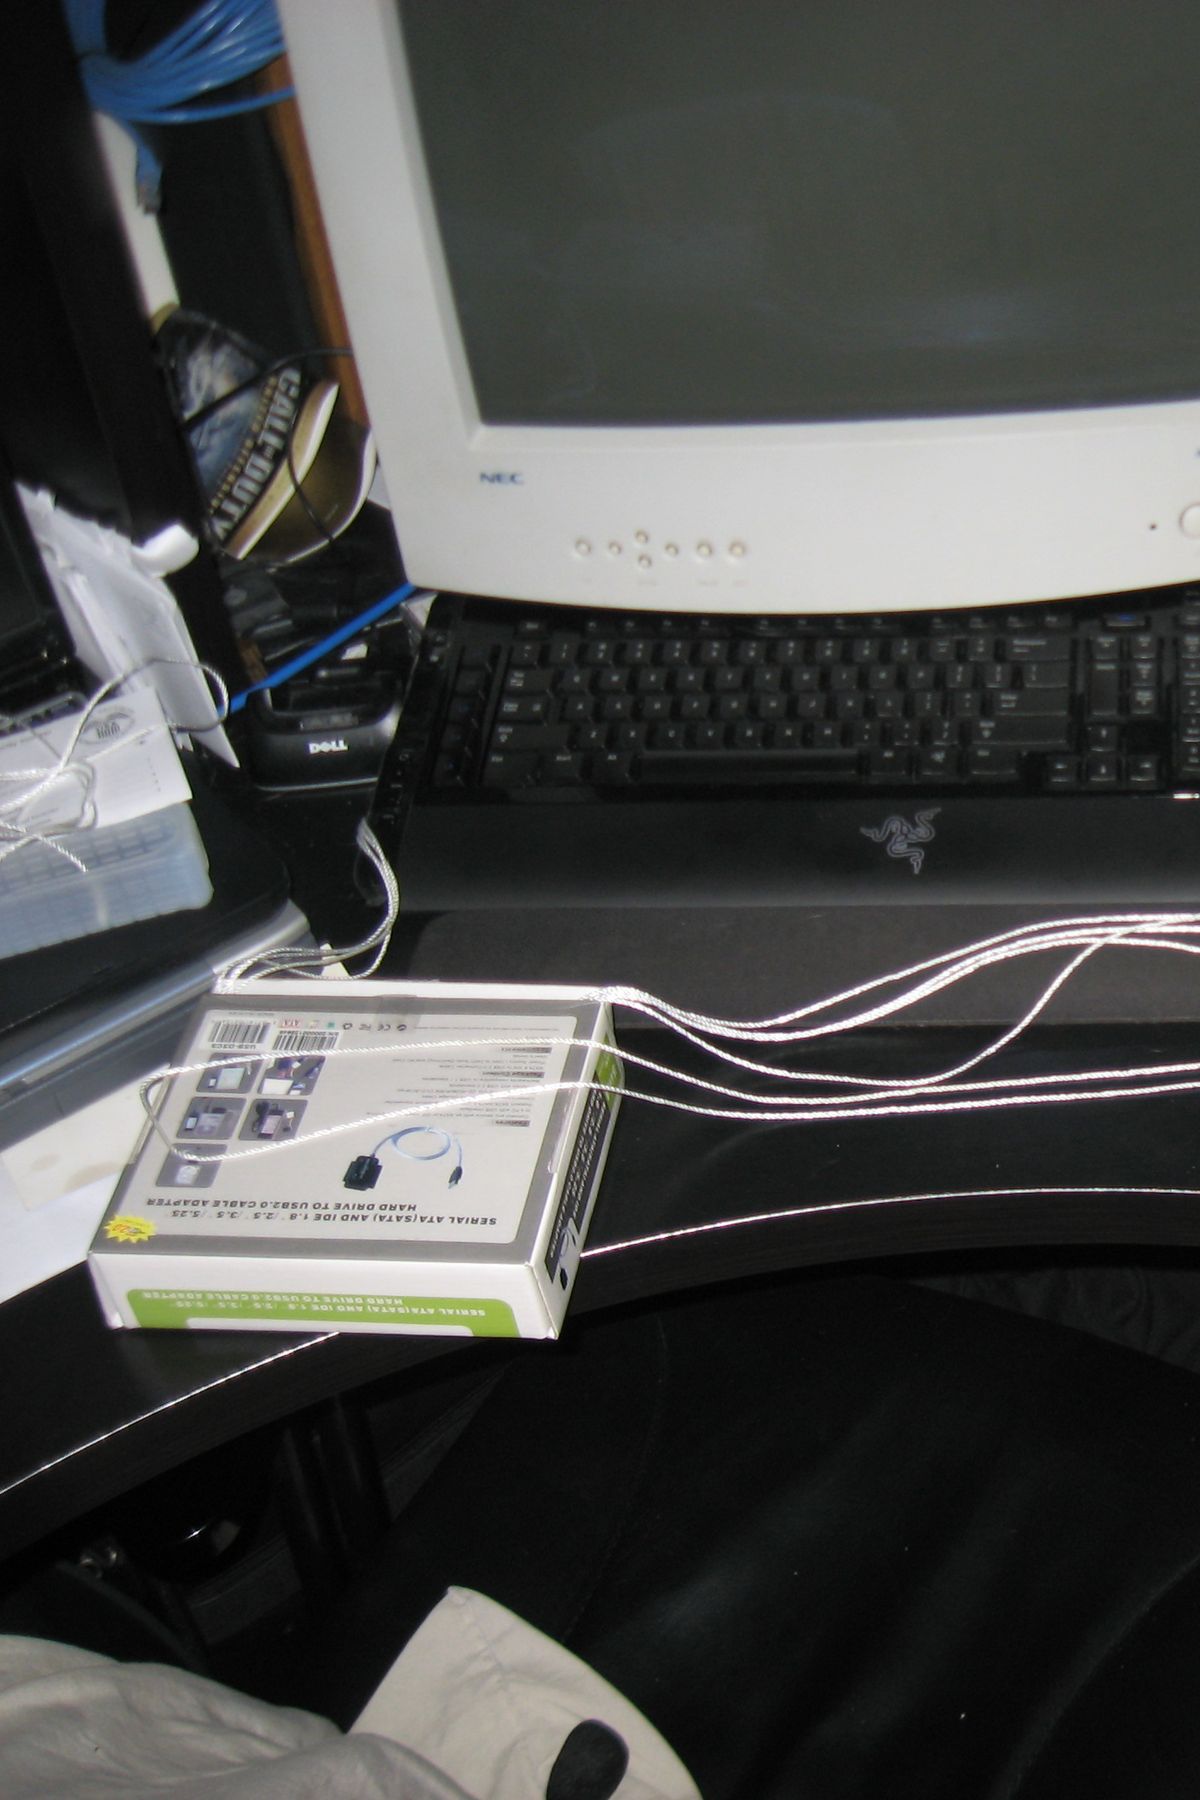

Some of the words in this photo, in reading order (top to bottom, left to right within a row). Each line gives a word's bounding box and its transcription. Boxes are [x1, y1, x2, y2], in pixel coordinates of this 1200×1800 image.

[257, 367, 301, 451] CALL
[479, 472, 525, 485] NEC
[211, 452, 275, 540] DUTY
[309, 739, 349, 755] DELL
[146, 1198, 210, 1207] ADAPTER
[213, 1200, 256, 1209] CABLE
[260, 1201, 309, 1210] USB2.0
[313, 1202, 329, 1210] TO
[333, 1202, 375, 1211] DRIVE
[379, 1203, 417, 1212] HARD
[313, 1213, 336, 1222] IDE
[340, 1213, 369, 1222] AND
[373, 1213, 445, 1224] ATA(SATA)
[449, 1216, 497, 1226] SERIAL
[141, 1291, 203, 1300] ADAPTER
[207, 1292, 249, 1300] CABLE
[323, 1296, 362, 1304] DRIVE
[366, 1297, 403, 1305] HARD
[336, 1304, 363, 1312] AND
[439, 1308, 486, 1316] SERIAL
